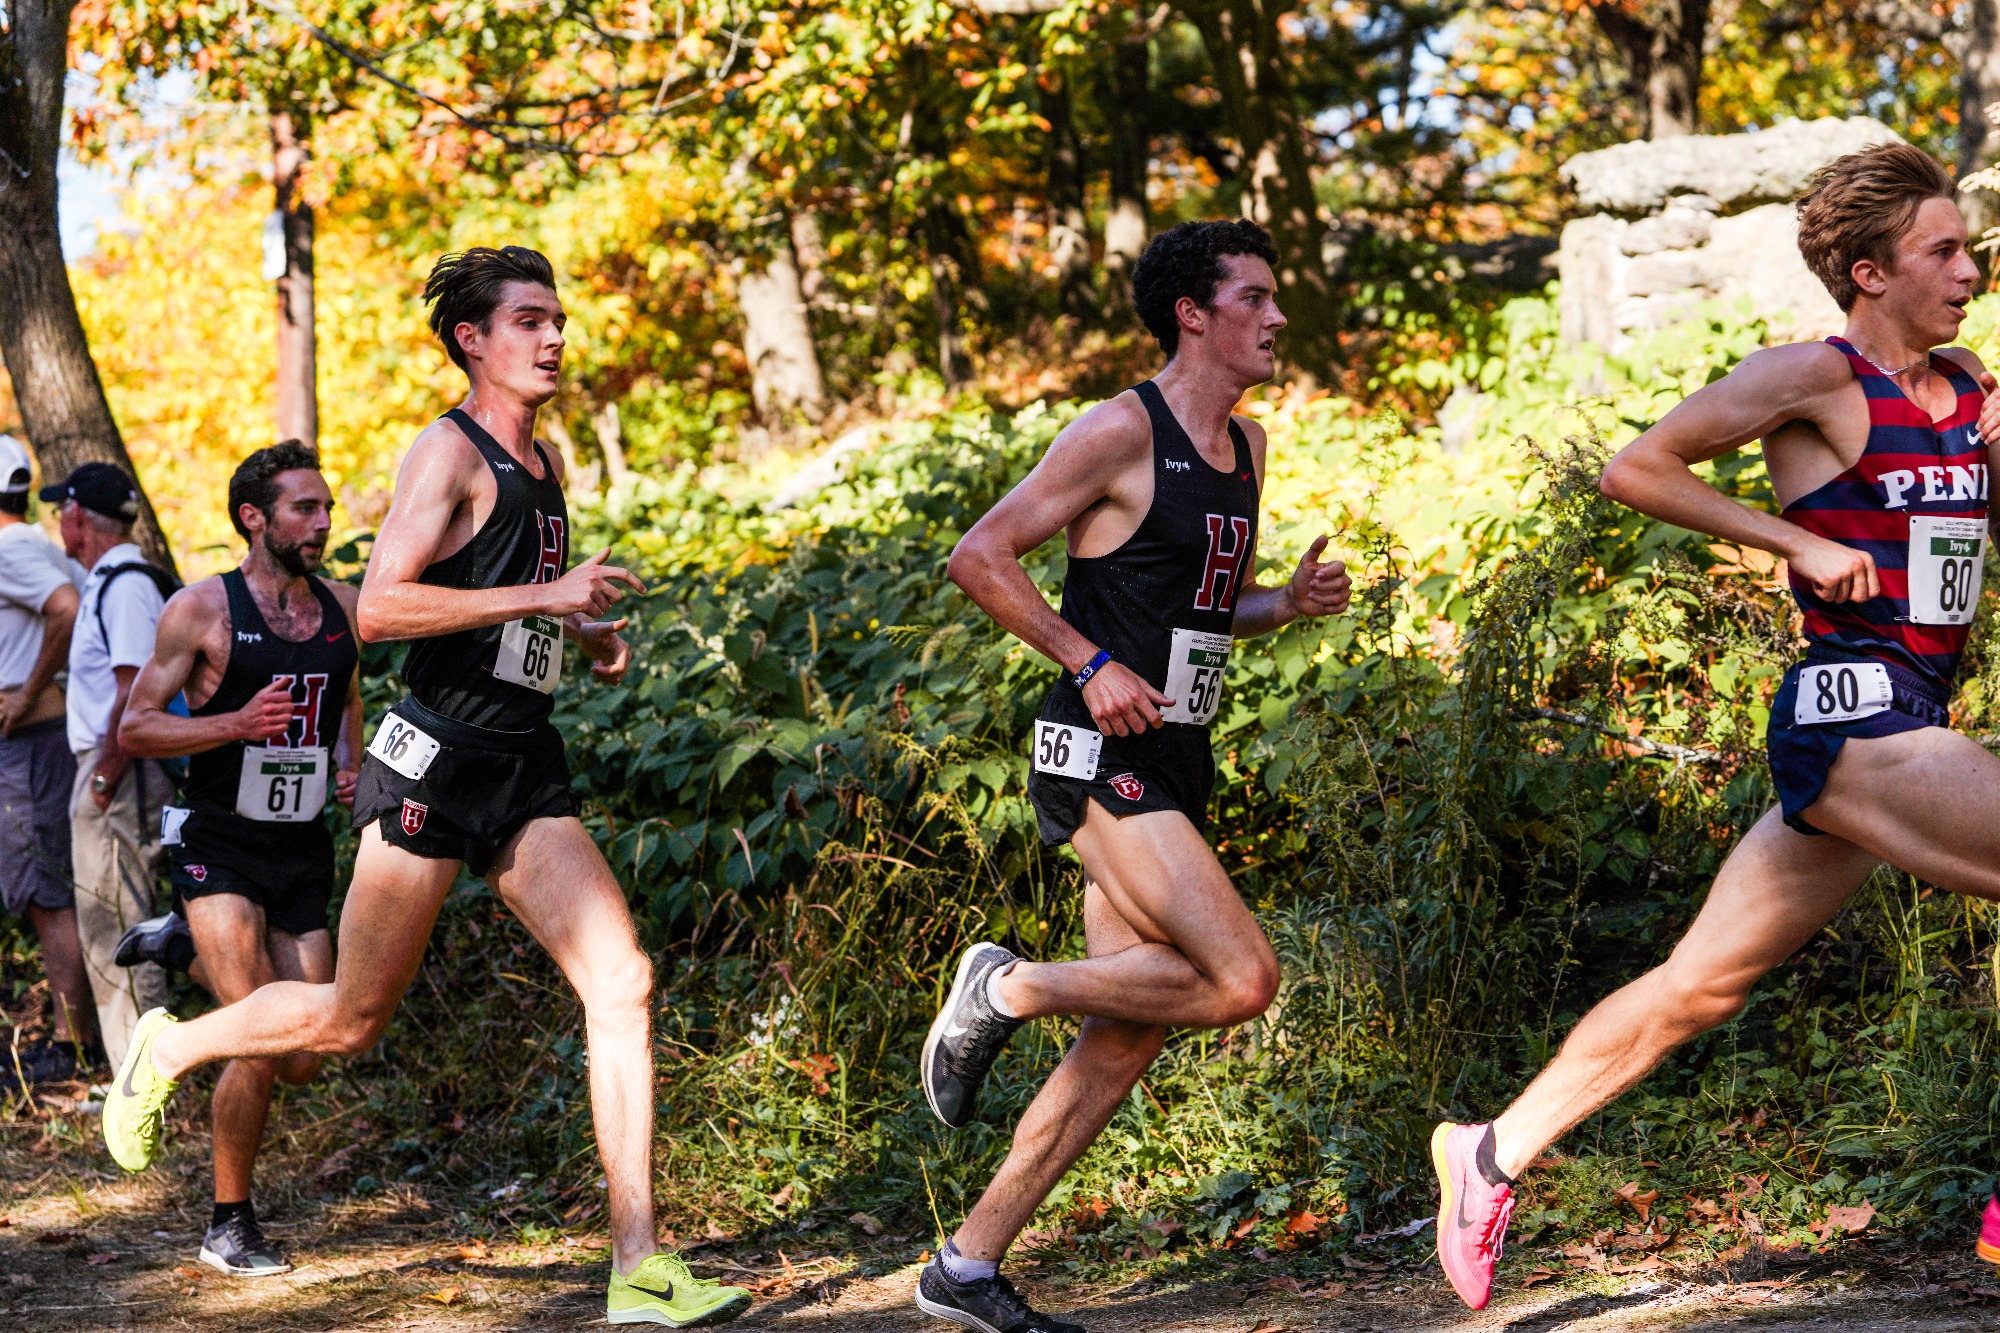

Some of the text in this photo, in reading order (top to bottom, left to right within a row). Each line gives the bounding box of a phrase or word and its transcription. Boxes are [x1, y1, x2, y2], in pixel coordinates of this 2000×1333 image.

[1165, 458, 1182, 472] Ivy
[530, 508, 564, 584] H
[1193, 513, 1249, 612] H
[1949, 539, 1964, 554] Ivy
[1940, 558, 1973, 612] 80
[237, 631, 254, 643] Ivy
[523, 633, 552, 681] 66
[1204, 652, 1217, 665] Ivy
[266, 673, 329, 748] H
[1188, 668, 1220, 714] 56
[1816, 667, 1859, 714] 80
[383, 722, 416, 761] 66
[1040, 726, 1072, 767] 56
[267, 776, 304, 813] 61
[405, 808, 420, 828] H
